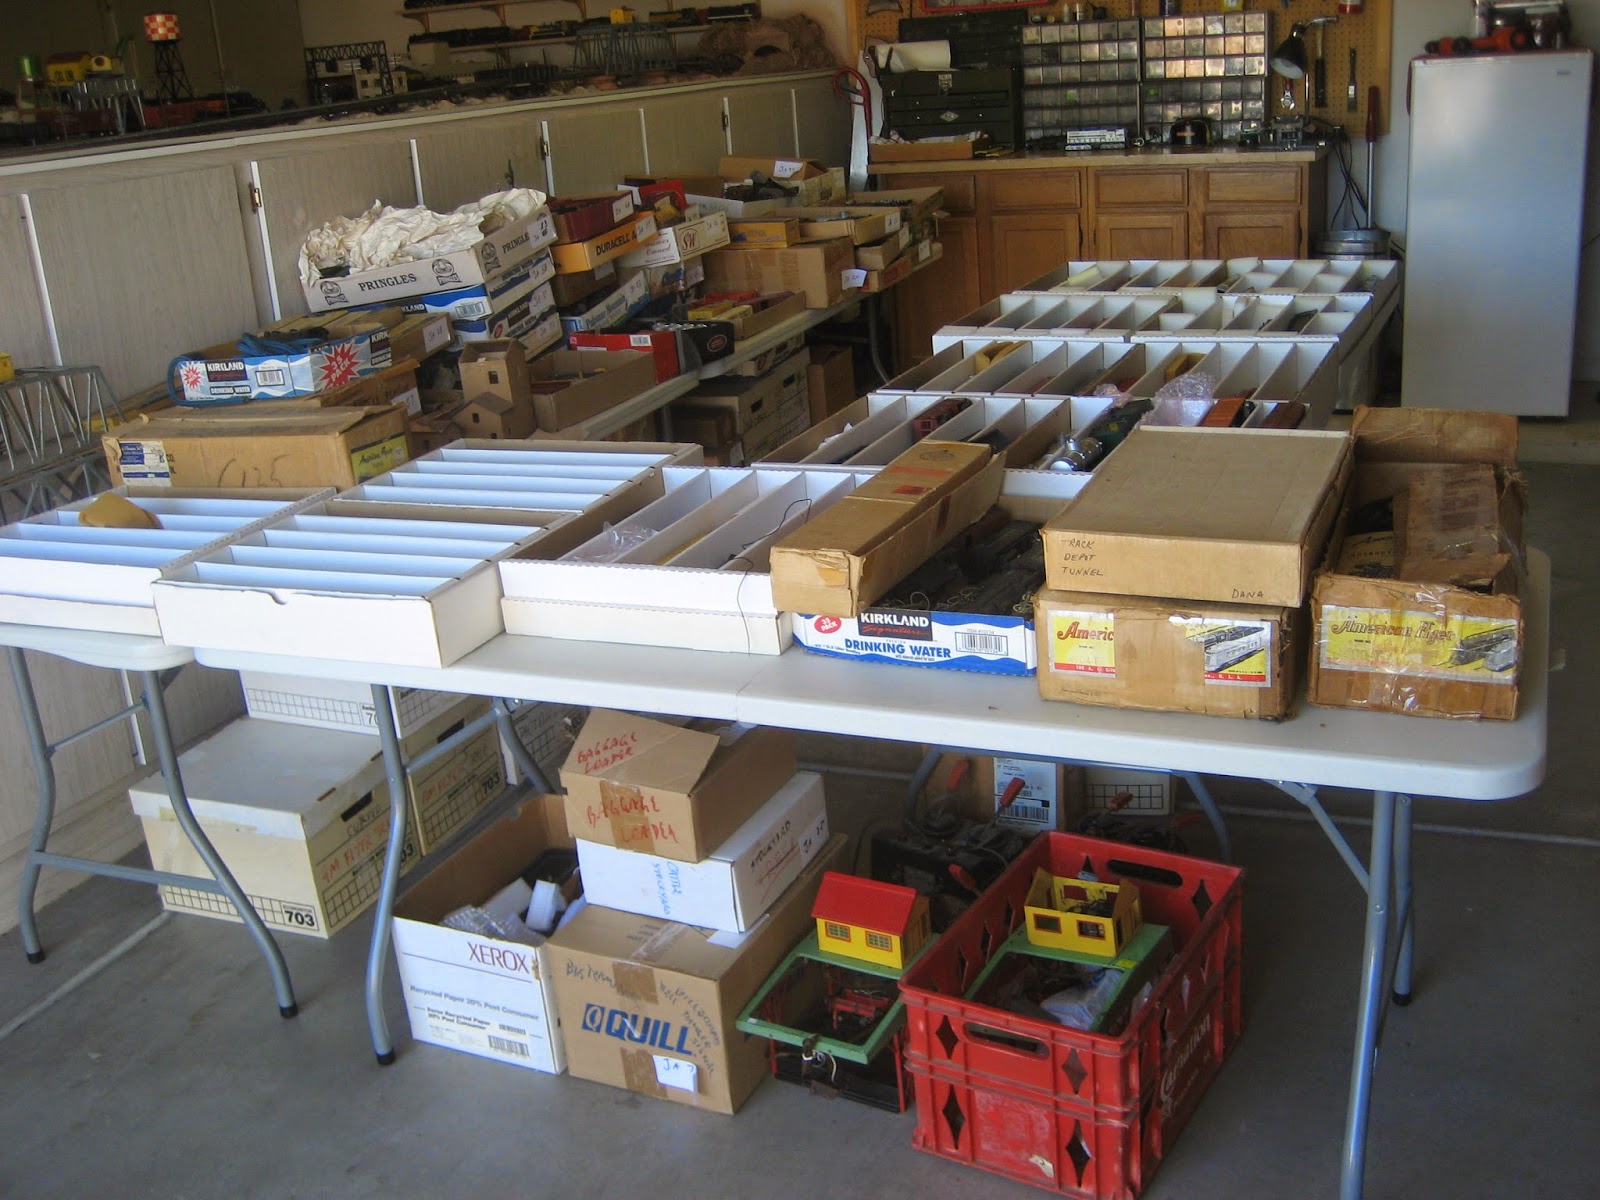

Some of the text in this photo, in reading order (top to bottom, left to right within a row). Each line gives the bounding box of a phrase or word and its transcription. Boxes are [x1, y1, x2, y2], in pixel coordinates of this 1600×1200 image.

[502, 232, 531, 254] PRINGLE
[596, 232, 630, 257] DURACELL
[358, 273, 418, 292] PRINGLES
[400, 303, 426, 313] KLAND
[371, 330, 390, 343] KIRK
[206, 361, 245, 372] KIRKLAND
[331, 355, 343, 370] 35
[331, 358, 352, 382] PACK
[1061, 538, 1096, 550] TRACK
[1063, 553, 1097, 562] DEPOT
[1061, 566, 1104, 577] TUNNEL
[1231, 588, 1265, 599] DANA
[820, 620, 838, 632] PACK
[860, 612, 930, 628] KIRKLAND
[1056, 620, 1115, 642] Americ
[1331, 615, 1457, 646] American Flyer
[844, 638, 952, 659] DRINKING WATER
[577, 731, 639, 766] BAGGAGE
[481, 772, 500, 796] 703
[285, 910, 315, 927] 703
[467, 942, 530, 975] XEROX
[410, 985, 443, 998] Recycled
[444, 993, 465, 1003] Paper
[484, 1001, 501, 1012] Post
[501, 1005, 540, 1021] Consumer
[605, 1008, 693, 1056] QUILL
